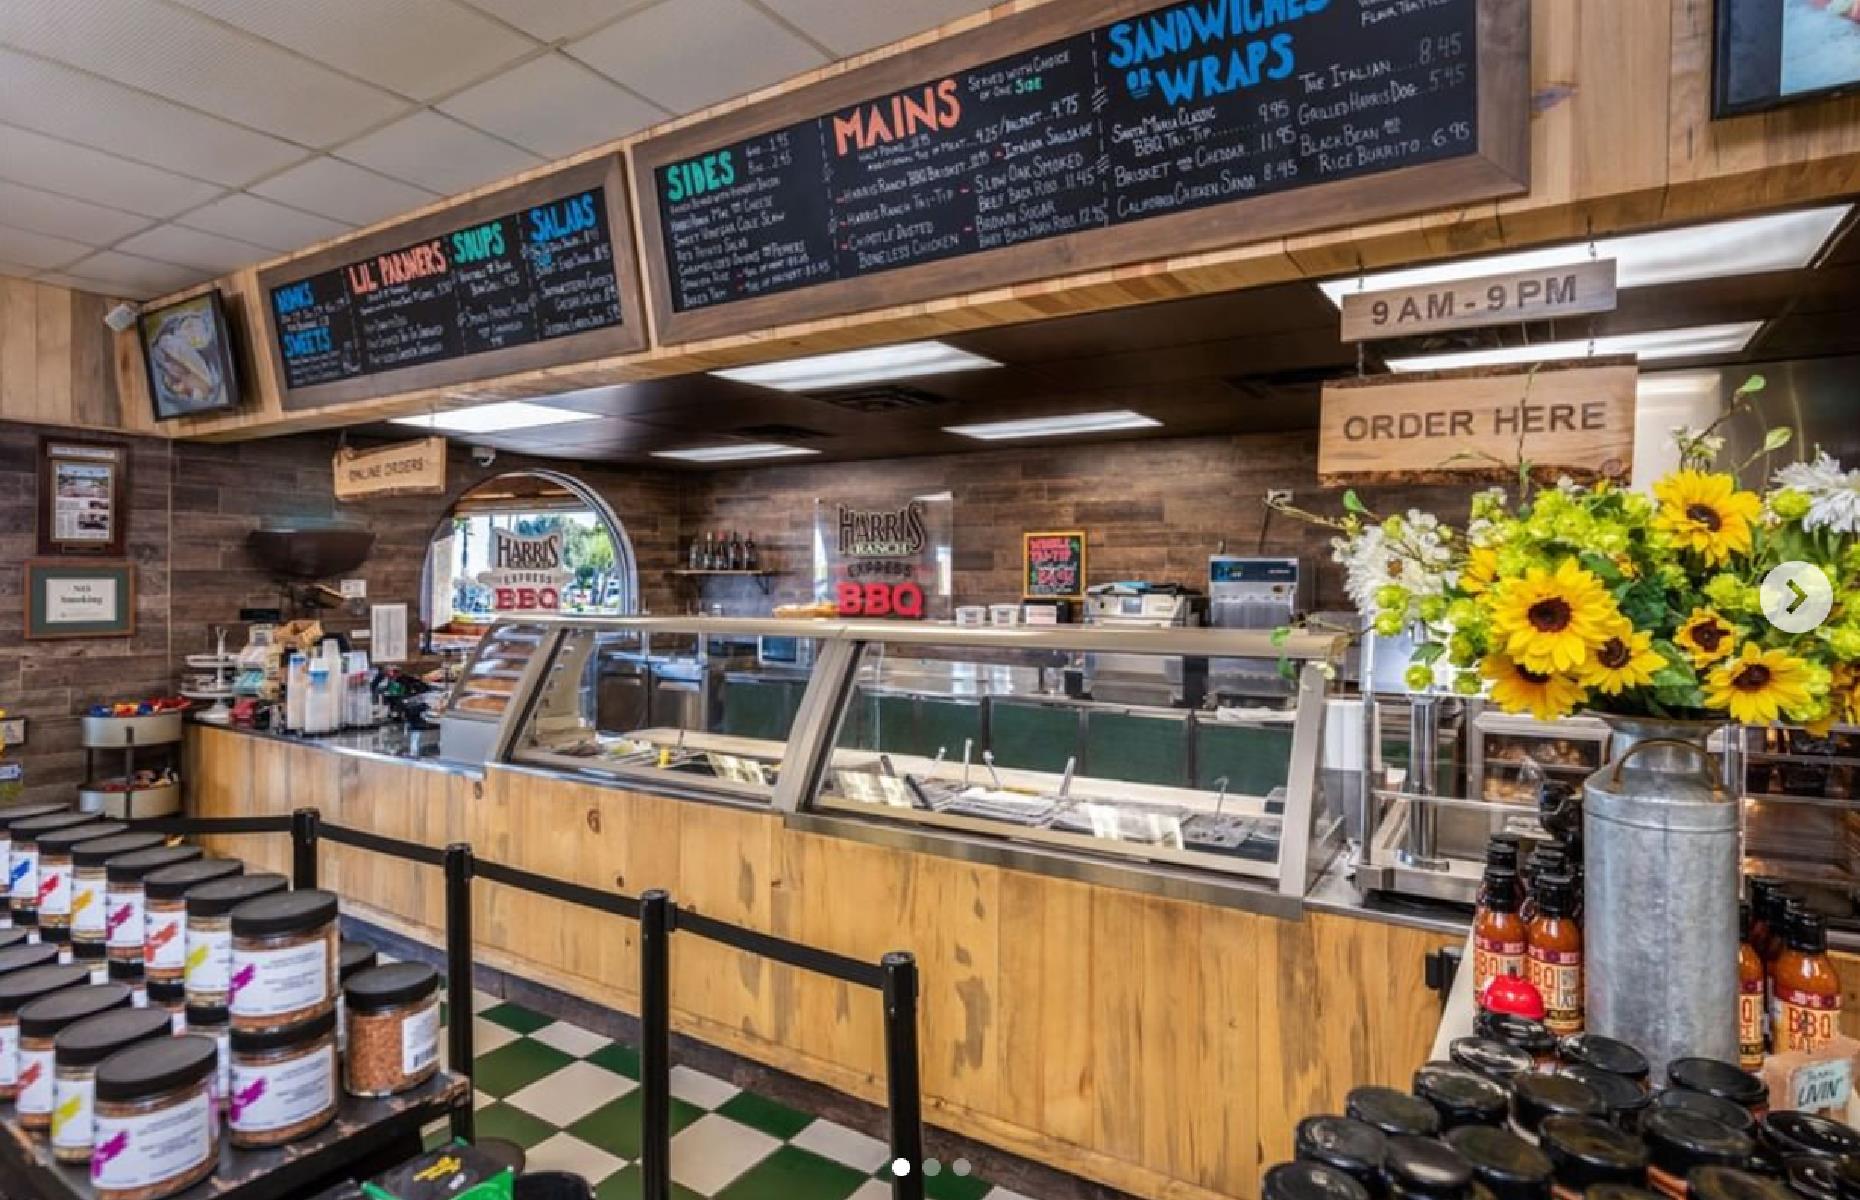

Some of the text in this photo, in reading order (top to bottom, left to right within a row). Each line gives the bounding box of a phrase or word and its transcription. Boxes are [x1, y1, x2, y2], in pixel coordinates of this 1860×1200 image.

[1107, 0, 1330, 69] SANDWICH
[1155, 32, 1295, 106] WRAPS
[1297, 71, 1326, 94] THE
[1328, 60, 1391, 88] ITALIAN
[832, 78, 961, 158] MAINS
[666, 150, 735, 202] SIDES
[1319, 152, 1353, 175] RICE
[1343, 401, 1607, 441] ORDER HERE
[837, 502, 927, 556] HARRIS
[496, 532, 559, 569] HARRIS
[495, 587, 559, 611] BBQ
[835, 581, 925, 619] BBQ
[1788, 1006, 1831, 1039] BBQ
